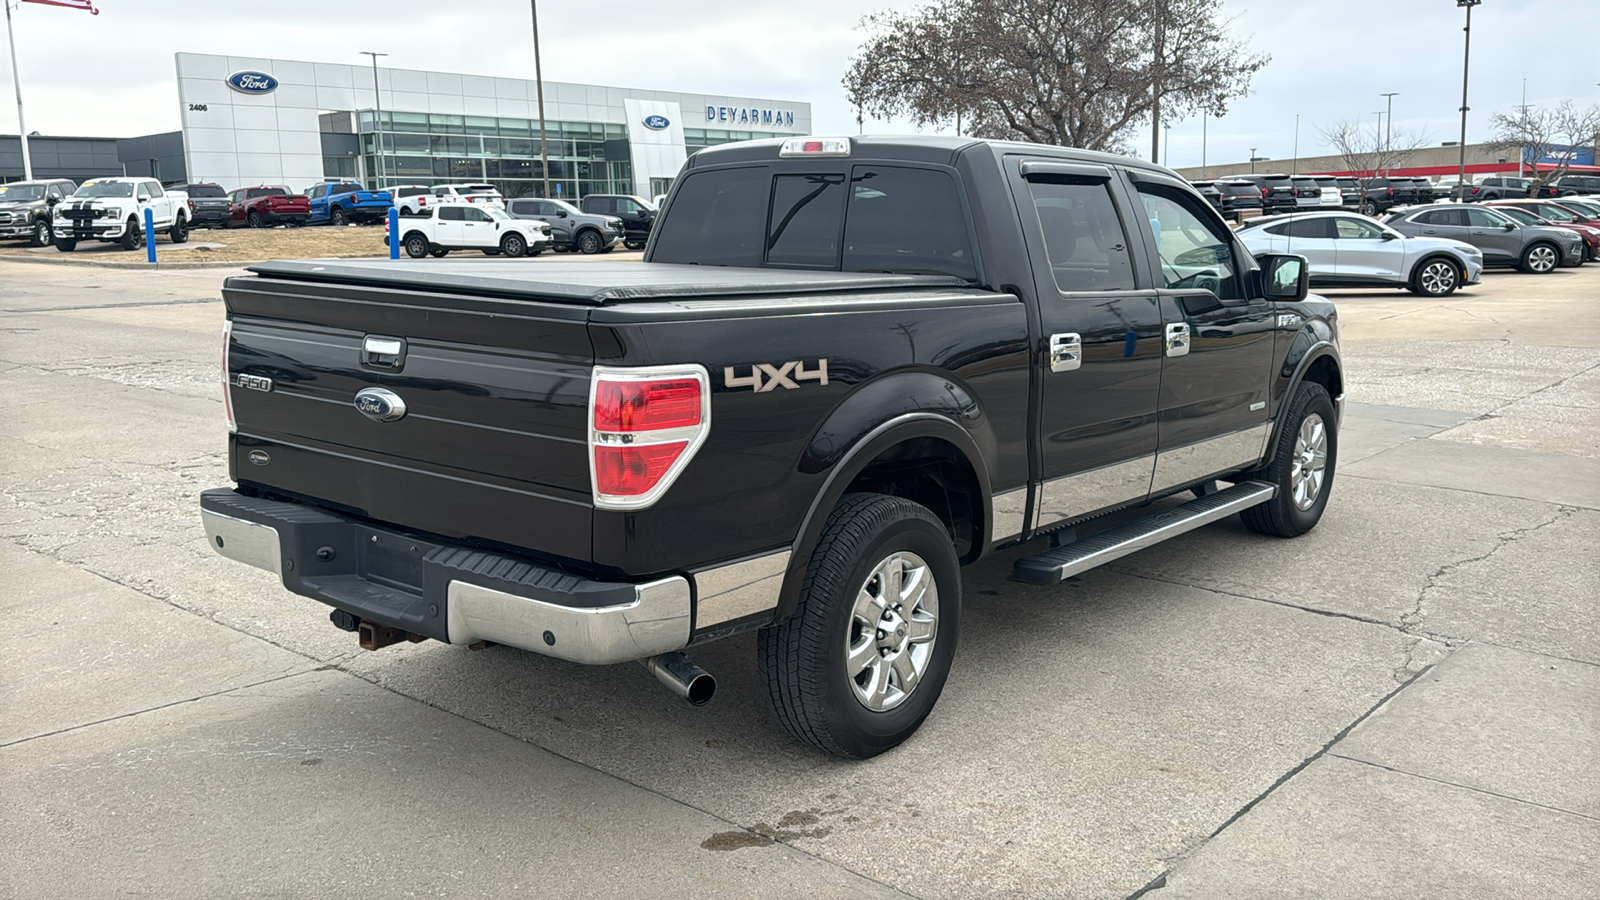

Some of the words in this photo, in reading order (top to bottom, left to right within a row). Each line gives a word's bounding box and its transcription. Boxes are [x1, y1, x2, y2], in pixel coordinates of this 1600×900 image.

[239, 74, 269, 90] Ford
[189, 104, 208, 112] 2406
[706, 105, 795, 125] DEYARMAN
[650, 117, 666, 128] Ford
[360, 397, 381, 413] Ford
